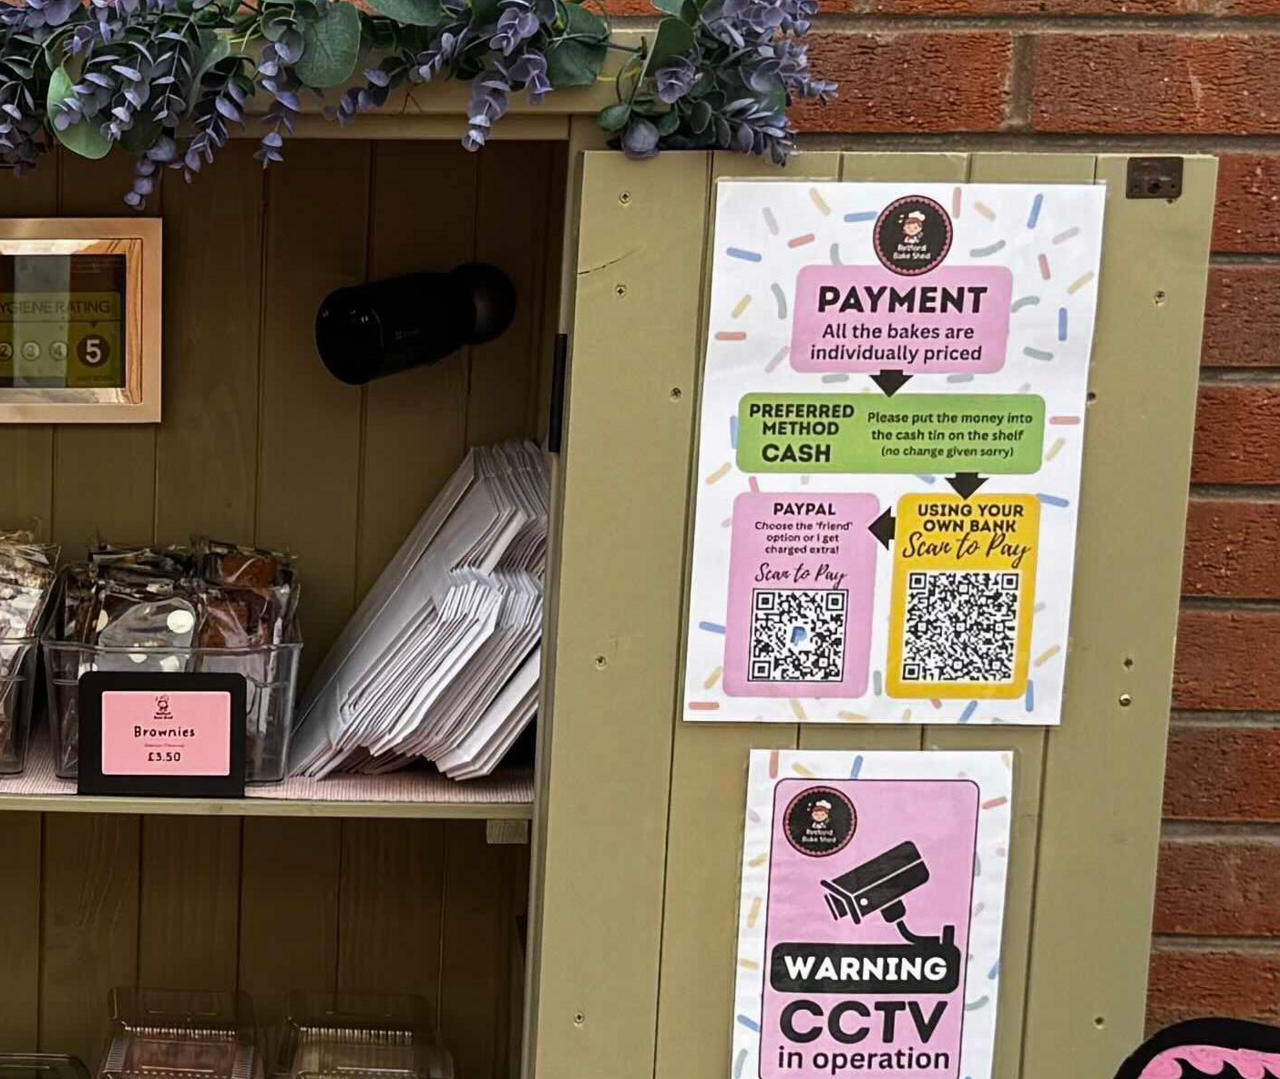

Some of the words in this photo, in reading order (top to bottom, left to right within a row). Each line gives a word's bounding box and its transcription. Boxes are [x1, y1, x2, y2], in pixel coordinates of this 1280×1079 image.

[55, 299, 111, 313] RATING
[818, 286, 988, 313] PAYMENT
[821, 323, 847, 339] All
[851, 323, 883, 339] the
[887, 323, 940, 339] bakes
[944, 327, 975, 340] are
[85, 339, 102, 364] 5
[811, 344, 918, 364] individually
[924, 346, 982, 364] priced
[749, 403, 855, 419] PREFERRED
[867, 411, 909, 423] Please
[911, 413, 934, 427] put
[936, 411, 959, 424] the
[961, 414, 1005, 427] money
[1007, 412, 1033, 424] into
[762, 421, 840, 436] METHOD
[871, 429, 893, 441] the
[895, 428, 925, 441] cash
[927, 429, 945, 441] tin
[948, 431, 965, 441] on
[967, 429, 989, 441] the
[991, 429, 1025, 441] shelf
[762, 444, 830, 462] CASH
[881, 445, 901, 457] (no
[902, 445, 945, 459] change
[945, 445, 978, 459] given
[979, 447, 1014, 460] sorry)
[773, 502, 837, 516] PAYPAL
[917, 503, 973, 517] USING
[977, 503, 1024, 518] YOUR
[754, 521, 794, 531] Choose
[795, 521, 813, 531] the
[922, 519, 965, 533] OWN
[969, 519, 1017, 534] BANK
[766, 532, 801, 544] option
[802, 534, 815, 543] or
[821, 533, 839, 545] get
[764, 544, 807, 557] charged
[809, 545, 840, 555] extra!
[902, 531, 952, 558] Scan
[956, 532, 980, 560] to
[985, 532, 1032, 569] Pay
[755, 562, 791, 582] Scan
[793, 563, 810, 583] to
[814, 563, 847, 590] Pay
[133, 725, 195, 738] Brownies
[147, 751, 181, 762] £3.50
[784, 956, 946, 980] WARNING
[780, 1000, 948, 1044] CCTV
[778, 1046, 803, 1069] in
[813, 1047, 949, 1074] operation
